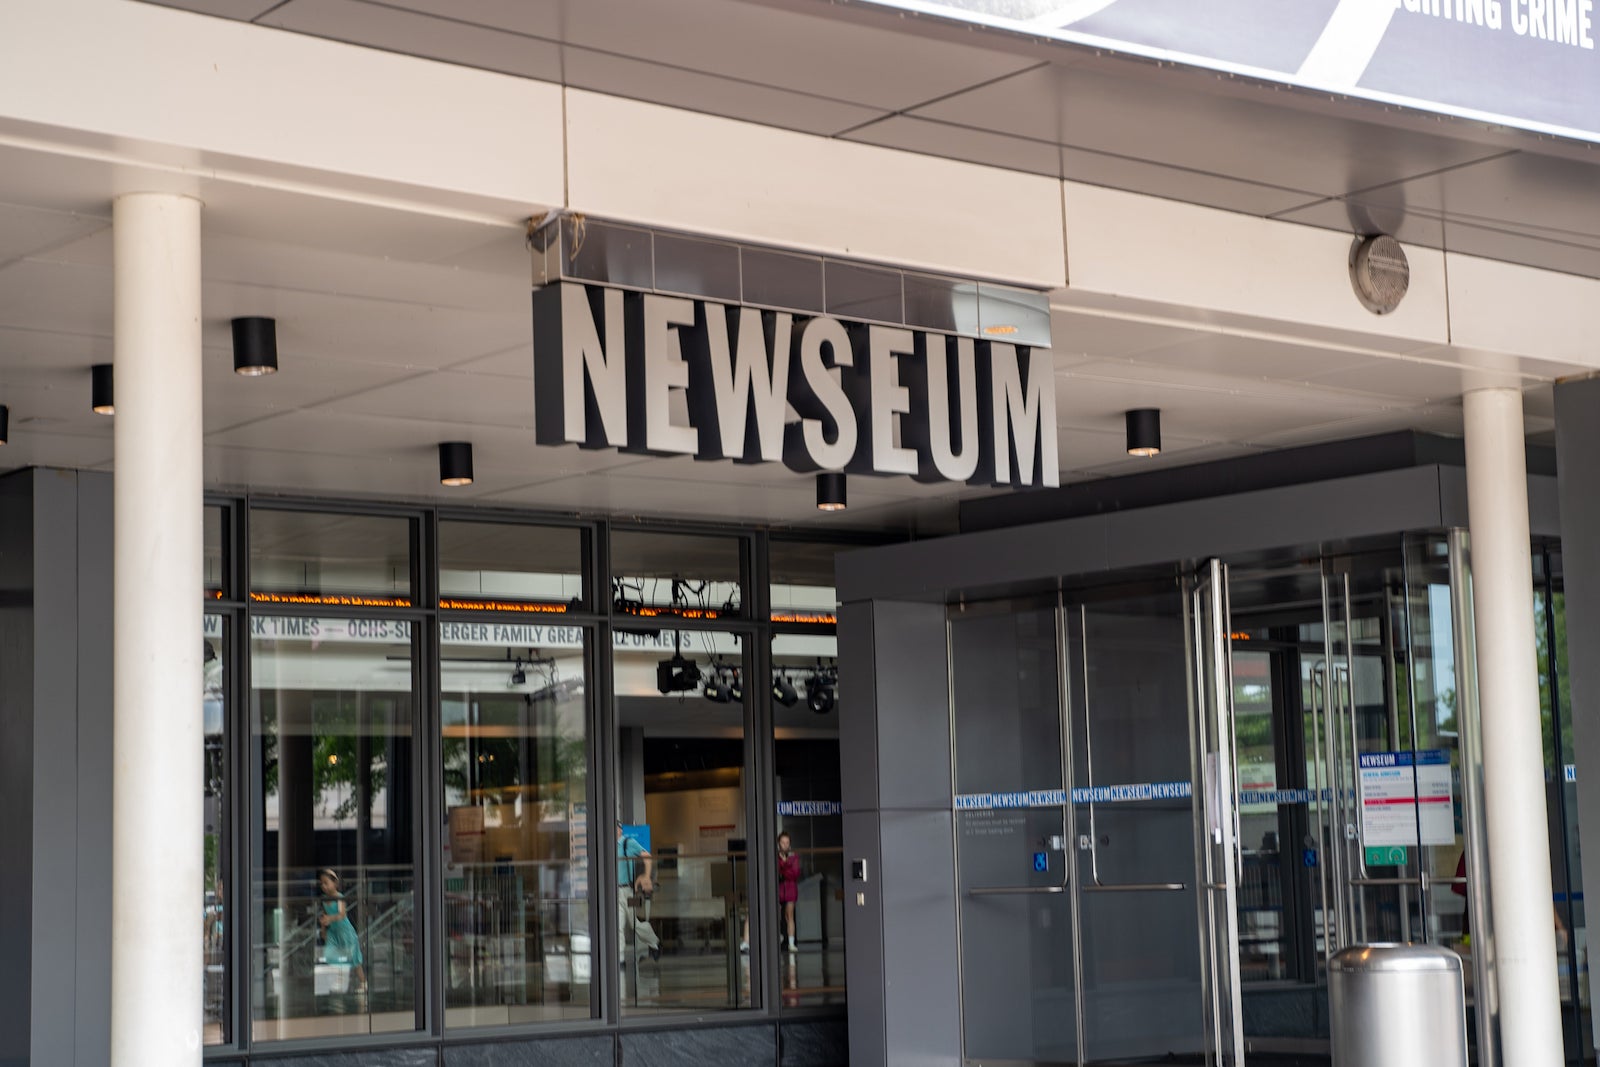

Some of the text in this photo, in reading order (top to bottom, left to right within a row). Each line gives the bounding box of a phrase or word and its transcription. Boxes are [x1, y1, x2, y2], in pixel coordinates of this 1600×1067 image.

[1402, 0, 1594, 49] ING CRIME
[561, 282, 1060, 489] NEWSEUM
[270, 616, 320, 636] TIMES
[440, 621, 488, 642] ERGER
[493, 623, 543, 643] FAMILY
[1361, 754, 1396, 767] NEWSEUM
[992, 792, 1029, 808] NEWSEUM
[1072, 782, 1192, 803] NEWSEUM NEWSEUM NEWSEUM
